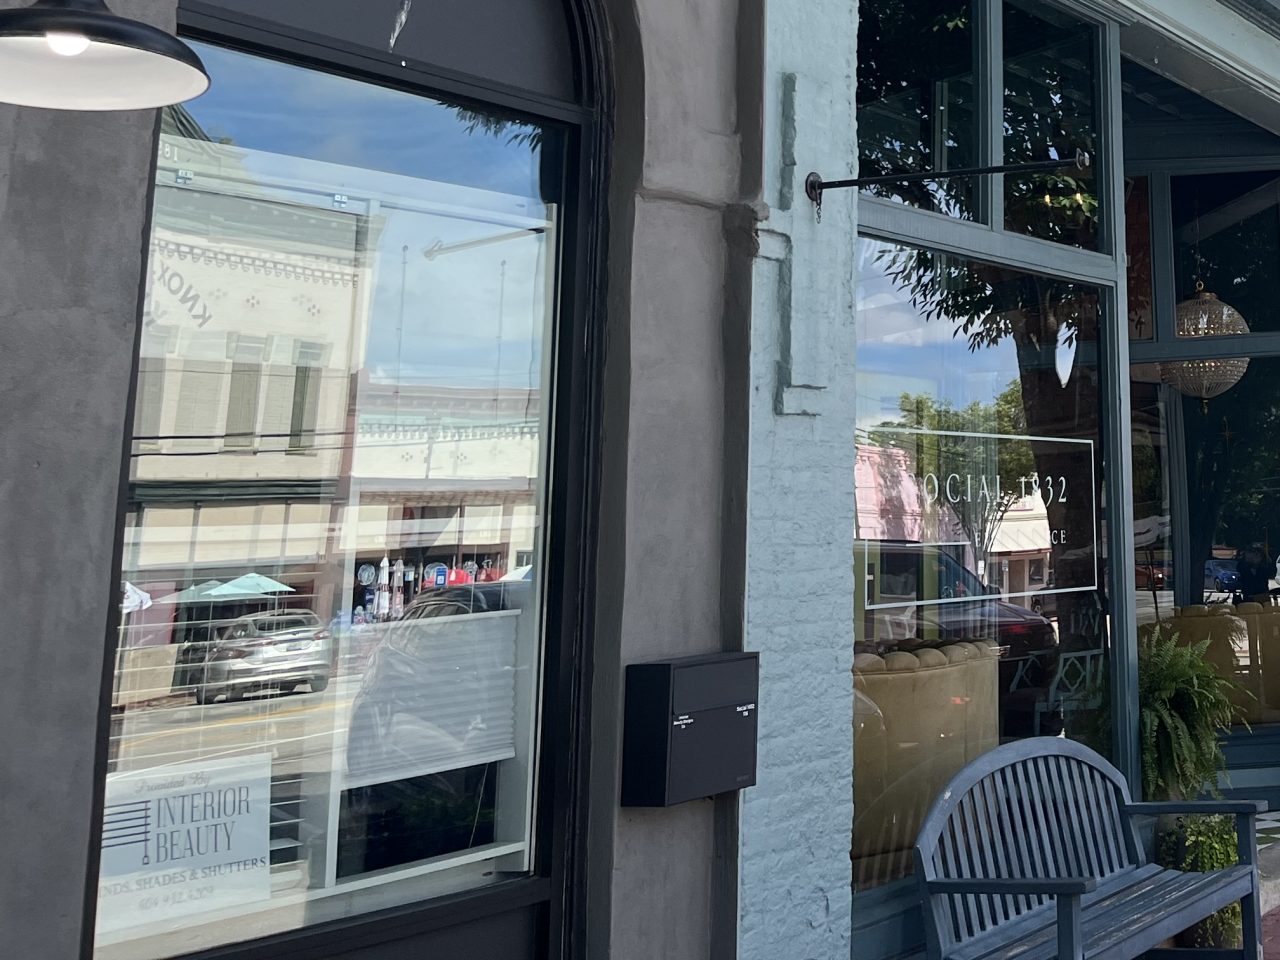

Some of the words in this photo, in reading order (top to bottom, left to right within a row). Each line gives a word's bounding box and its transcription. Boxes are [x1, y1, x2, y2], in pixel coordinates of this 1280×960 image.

[1020, 474, 1067, 507] 1832
[156, 786, 251, 828] INTERIOR
[155, 821, 236, 864] BEAUTY
[135, 871, 186, 890] SHADES
[189, 869, 199, 880] &
[201, 856, 266, 879] SHUTTERS
